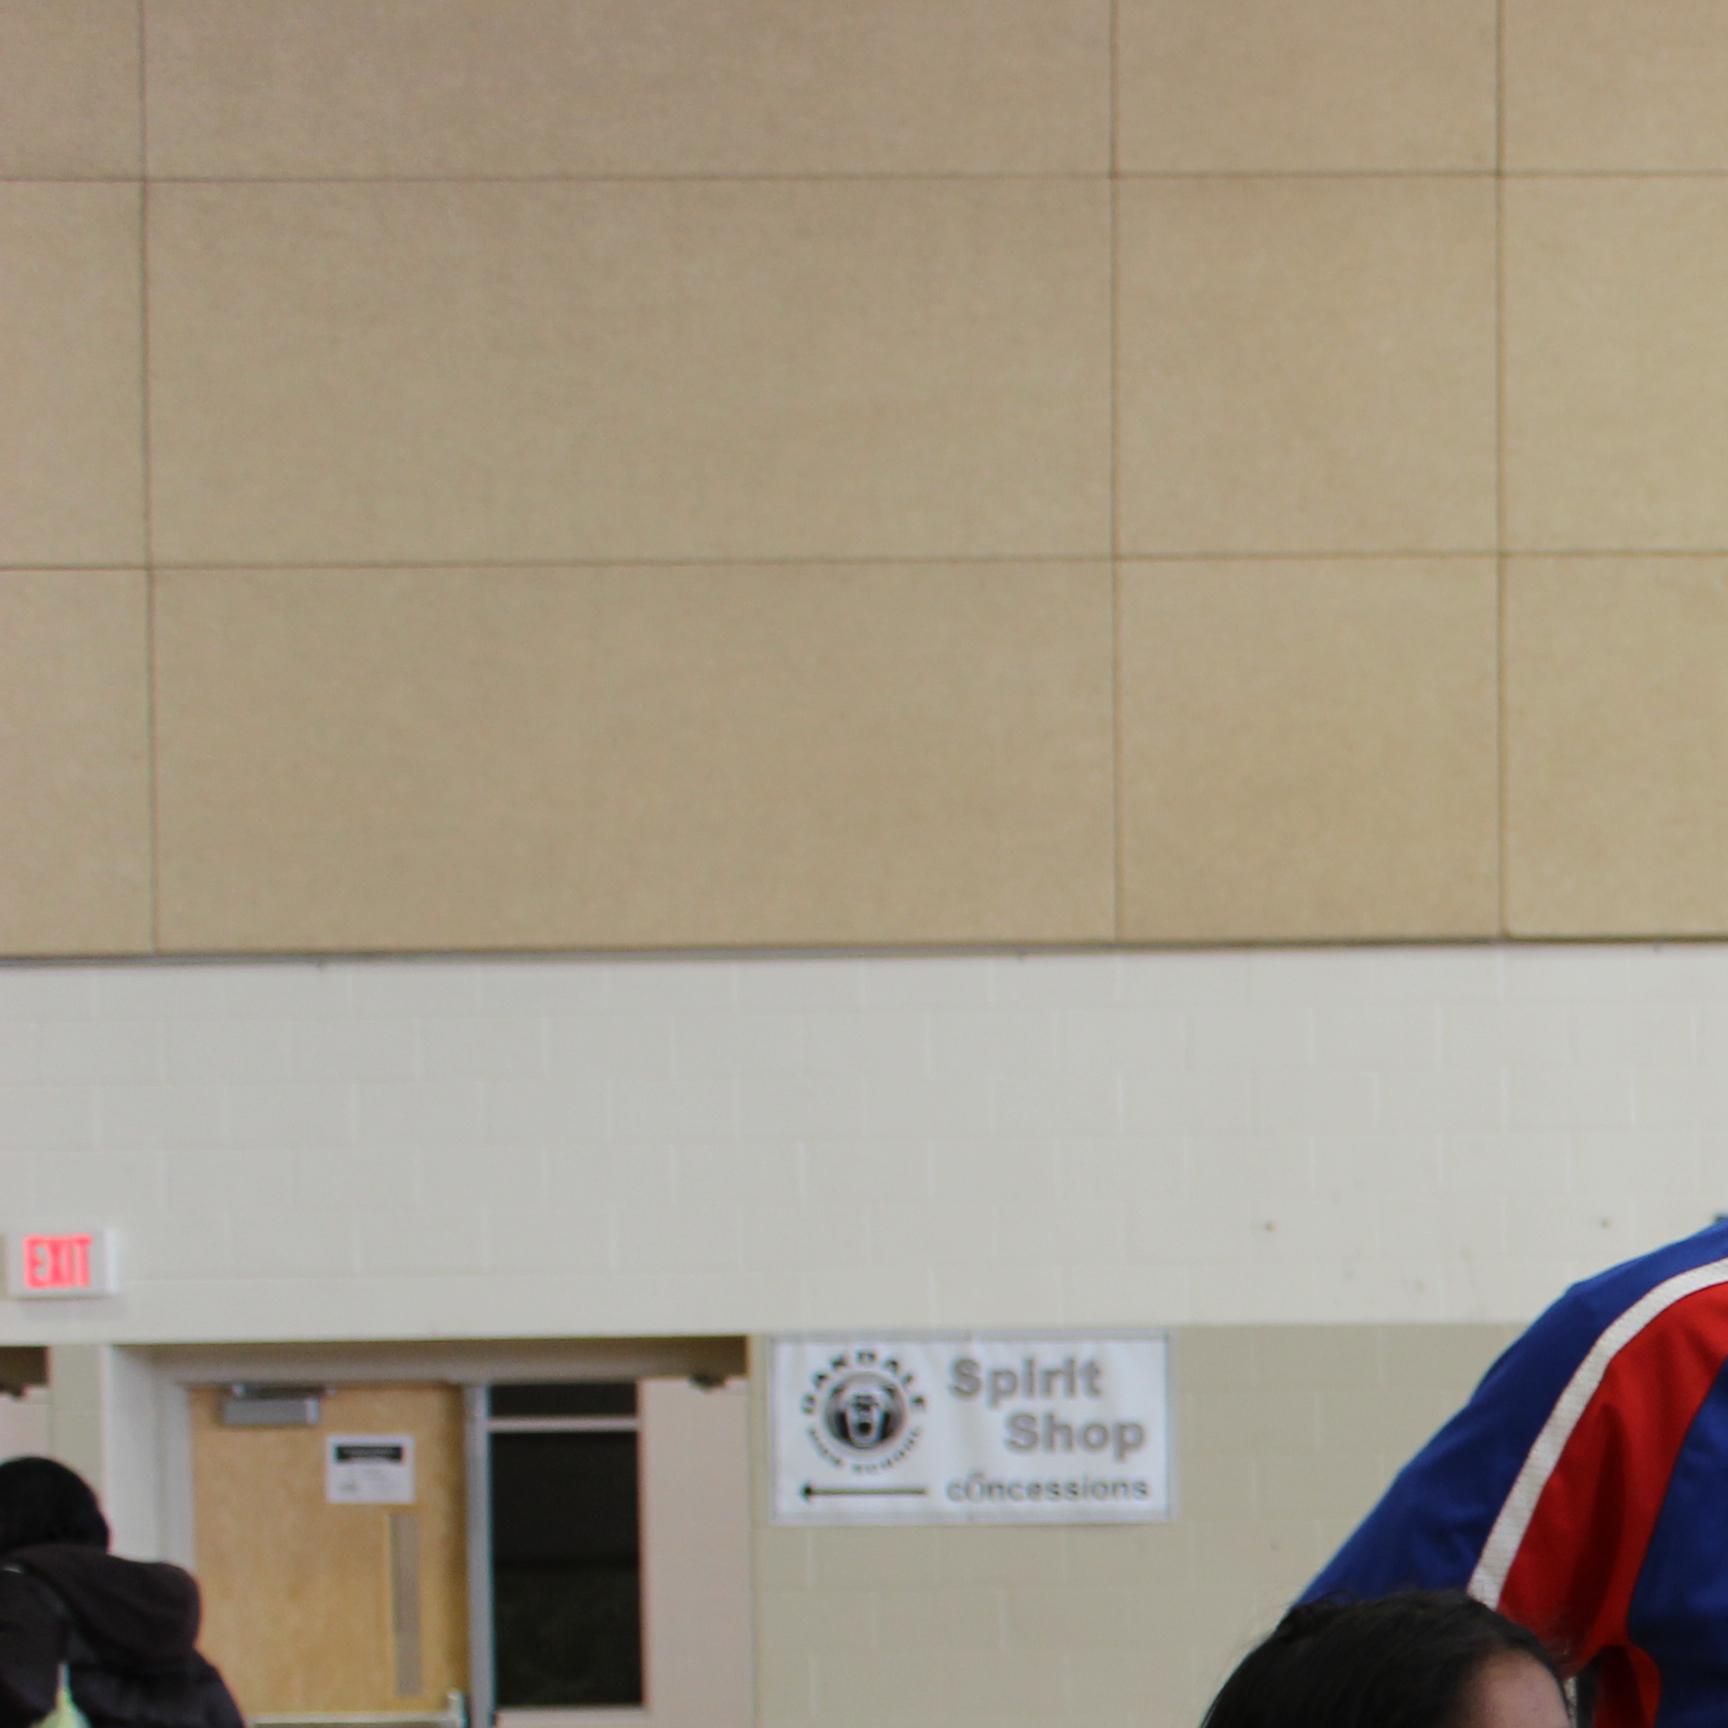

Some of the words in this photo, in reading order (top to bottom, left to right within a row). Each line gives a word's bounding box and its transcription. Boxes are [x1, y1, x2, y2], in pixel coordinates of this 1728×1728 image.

[23, 1234, 93, 1289] EXIT
[949, 1357, 1103, 1409] Spirit
[1005, 1411, 1147, 1461] Shop
